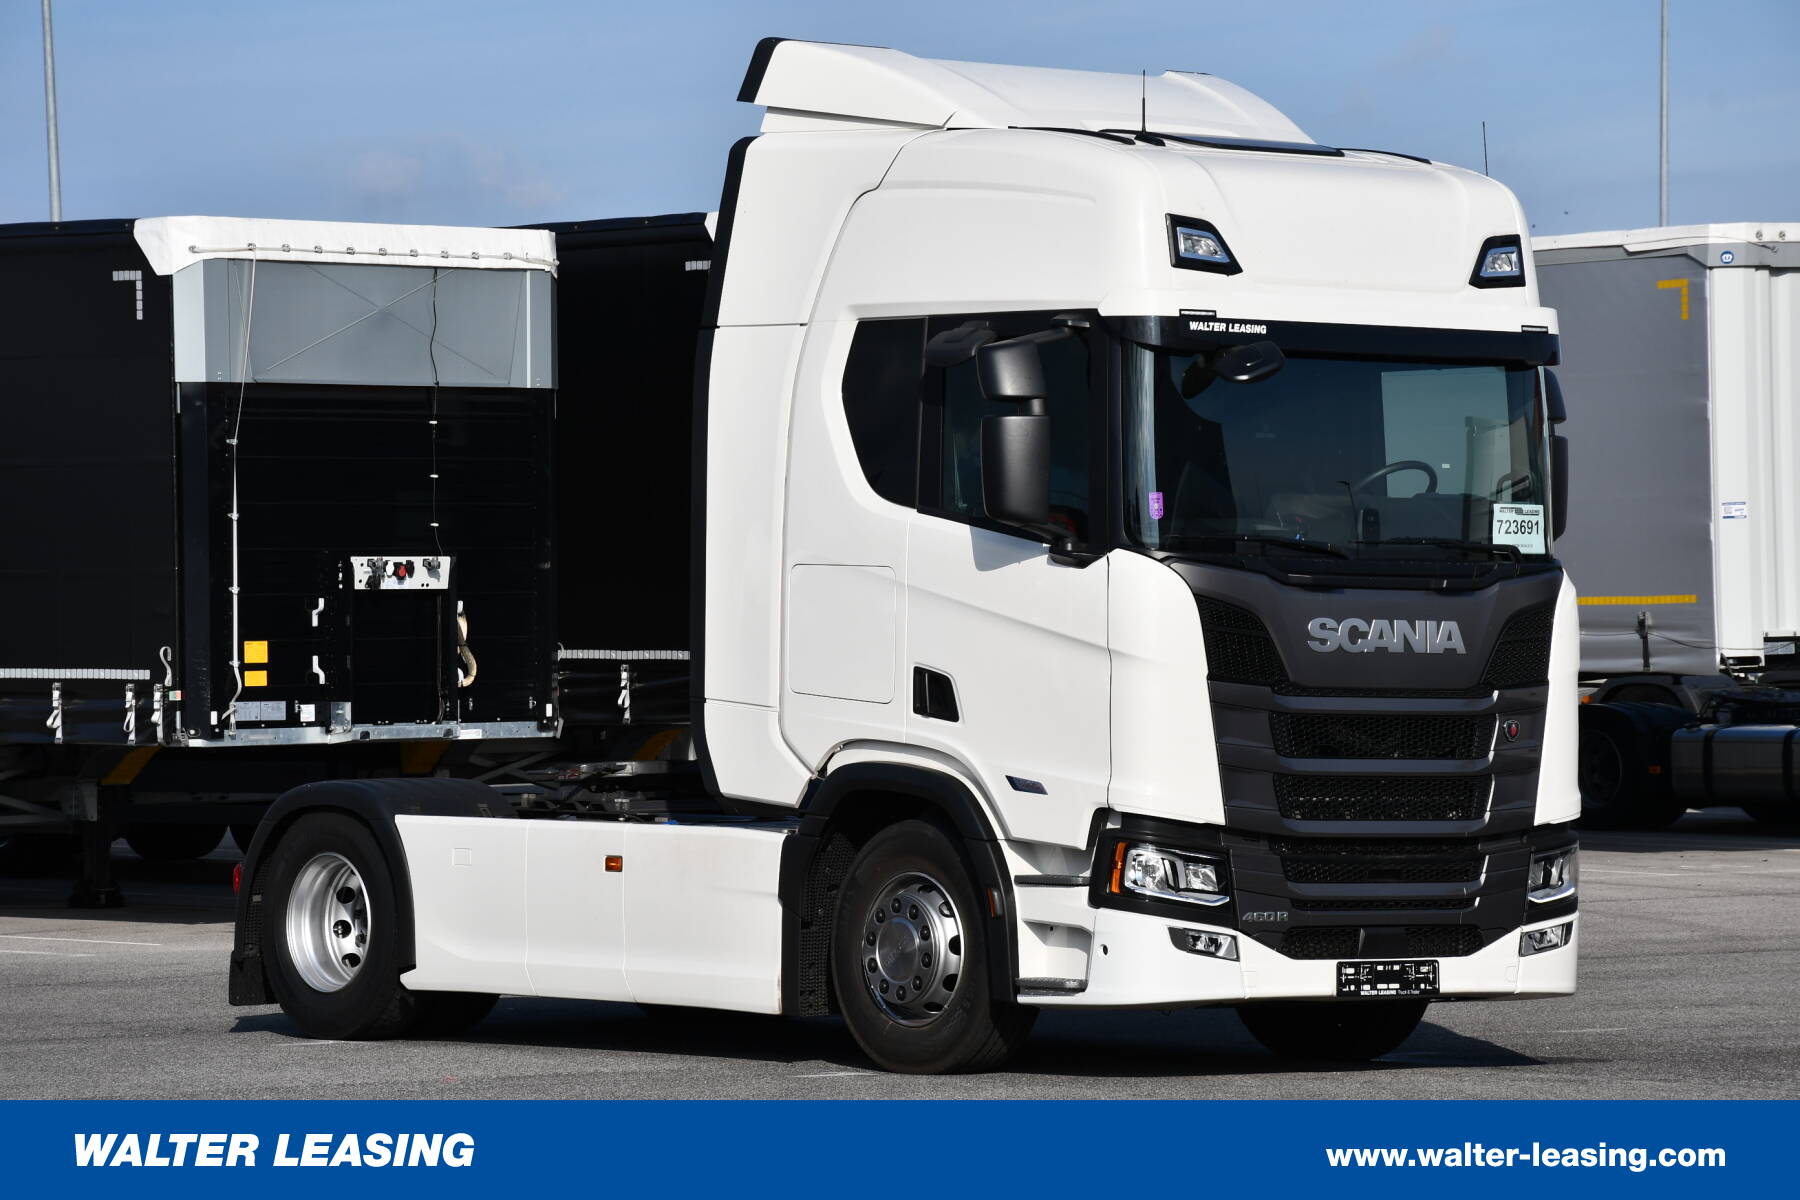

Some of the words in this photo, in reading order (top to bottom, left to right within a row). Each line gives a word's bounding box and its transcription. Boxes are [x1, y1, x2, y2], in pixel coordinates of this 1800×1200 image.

[1189, 321, 1226, 332] WALTER
[1228, 322, 1267, 334] LEASING
[1496, 519, 1540, 535] 723691
[1307, 617, 1467, 654] SCANIA
